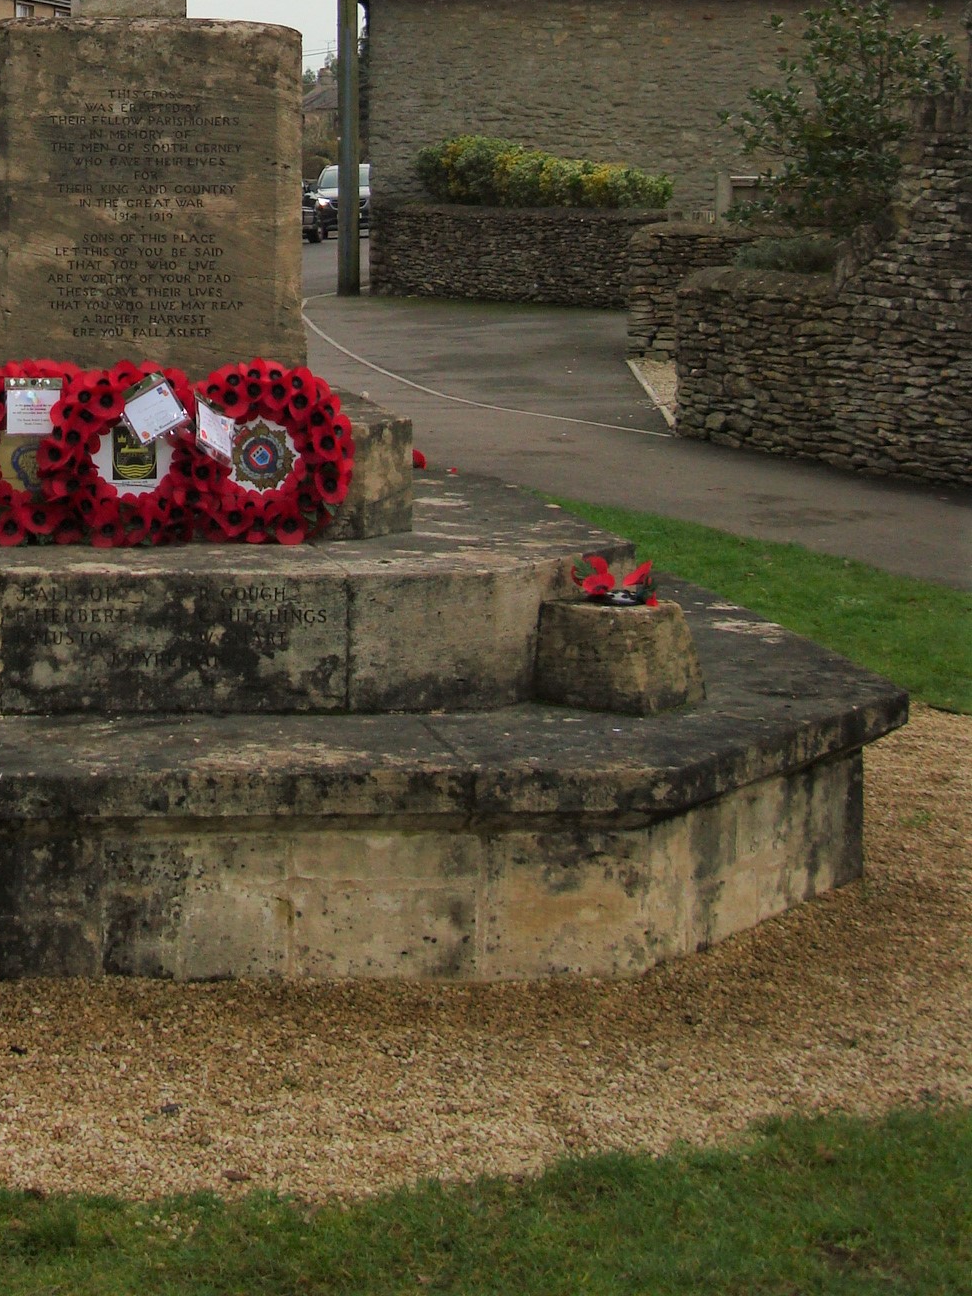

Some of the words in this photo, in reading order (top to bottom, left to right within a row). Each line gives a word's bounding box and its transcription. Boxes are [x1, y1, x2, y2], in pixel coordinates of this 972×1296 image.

[108, 89, 138, 99] THIS
[143, 90, 184, 100] CROSS
[85, 102, 114, 113] WAS
[50, 115, 86, 125] THEIR
[92, 115, 143, 125] FELLOW
[148, 116, 240, 126] PARISHIONERS
[89, 129, 103, 139] IN
[109, 129, 164, 140] MEMORY
[175, 130, 192, 139] OF
[51, 142, 74, 152] THE
[81, 143, 108, 153] MEN
[118, 143, 135, 153] OF
[143, 143, 188, 153] SOUTH
[194, 143, 242, 153] CERNEY
[72, 157, 102, 166] WHO
[109, 157, 140, 167] GAVE
[145, 157, 183, 167] THEIR
[187, 157, 226, 167] LIVES
[133, 170, 158, 180] FOR
[57, 183, 93, 194] THEIR
[100, 184, 129, 194] KING
[139, 184, 167, 194] AND
[174, 184, 236, 195] COUNTRY
[79, 198, 91, 208] IN
[96, 198, 119, 208] THE
[126, 198, 170, 208] GREAT
[175, 198, 204, 208] WAR
[83, 233, 114, 243] SONS
[120, 233, 135, 243] OF
[140, 233, 167, 243] THIS
[173, 234, 216, 243] PLACE
[55, 247, 79, 256] LET
[82, 247, 109, 257] THIS
[114, 247, 129, 256] OF
[138, 247, 163, 257] YOU
[171, 247, 187, 257] BE
[194, 247, 224, 257] SAID
[67, 260, 102, 270] THAT
[111, 260, 137, 270] YOU
[146, 260, 177, 270] WHO
[188, 260, 216, 271] LIVE
[47, 273, 73, 283] ARE
[79, 273, 132, 284] WORTHY
[139, 274, 154, 283] OF
[159, 274, 191, 283] YOUR
[198, 274, 231, 283] DEAD
[56, 287, 97, 297] THESE
[106, 287, 138, 297] GAVE
[145, 287, 181, 297] THEIR
[188, 287, 223, 297] LIVES
[48, 300, 80, 310] THAT
[84, 300, 109, 311] YOU
[114, 300, 144, 311] WHO
[150, 301, 176, 310] LIVE
[181, 301, 207, 311] MAY
[212, 301, 244, 311] REAP
[82, 315, 90, 323] A
[95, 314, 139, 324] RICHER
[149, 314, 206, 324] HARVEST
[73, 328, 95, 337] ERE
[101, 327, 124, 337] YOU
[133, 328, 162, 337] FALL
[166, 328, 212, 338] ASLEEP
[35, 608, 127, 624] HERBERT
[222, 608, 328, 624] HITCHINGS
